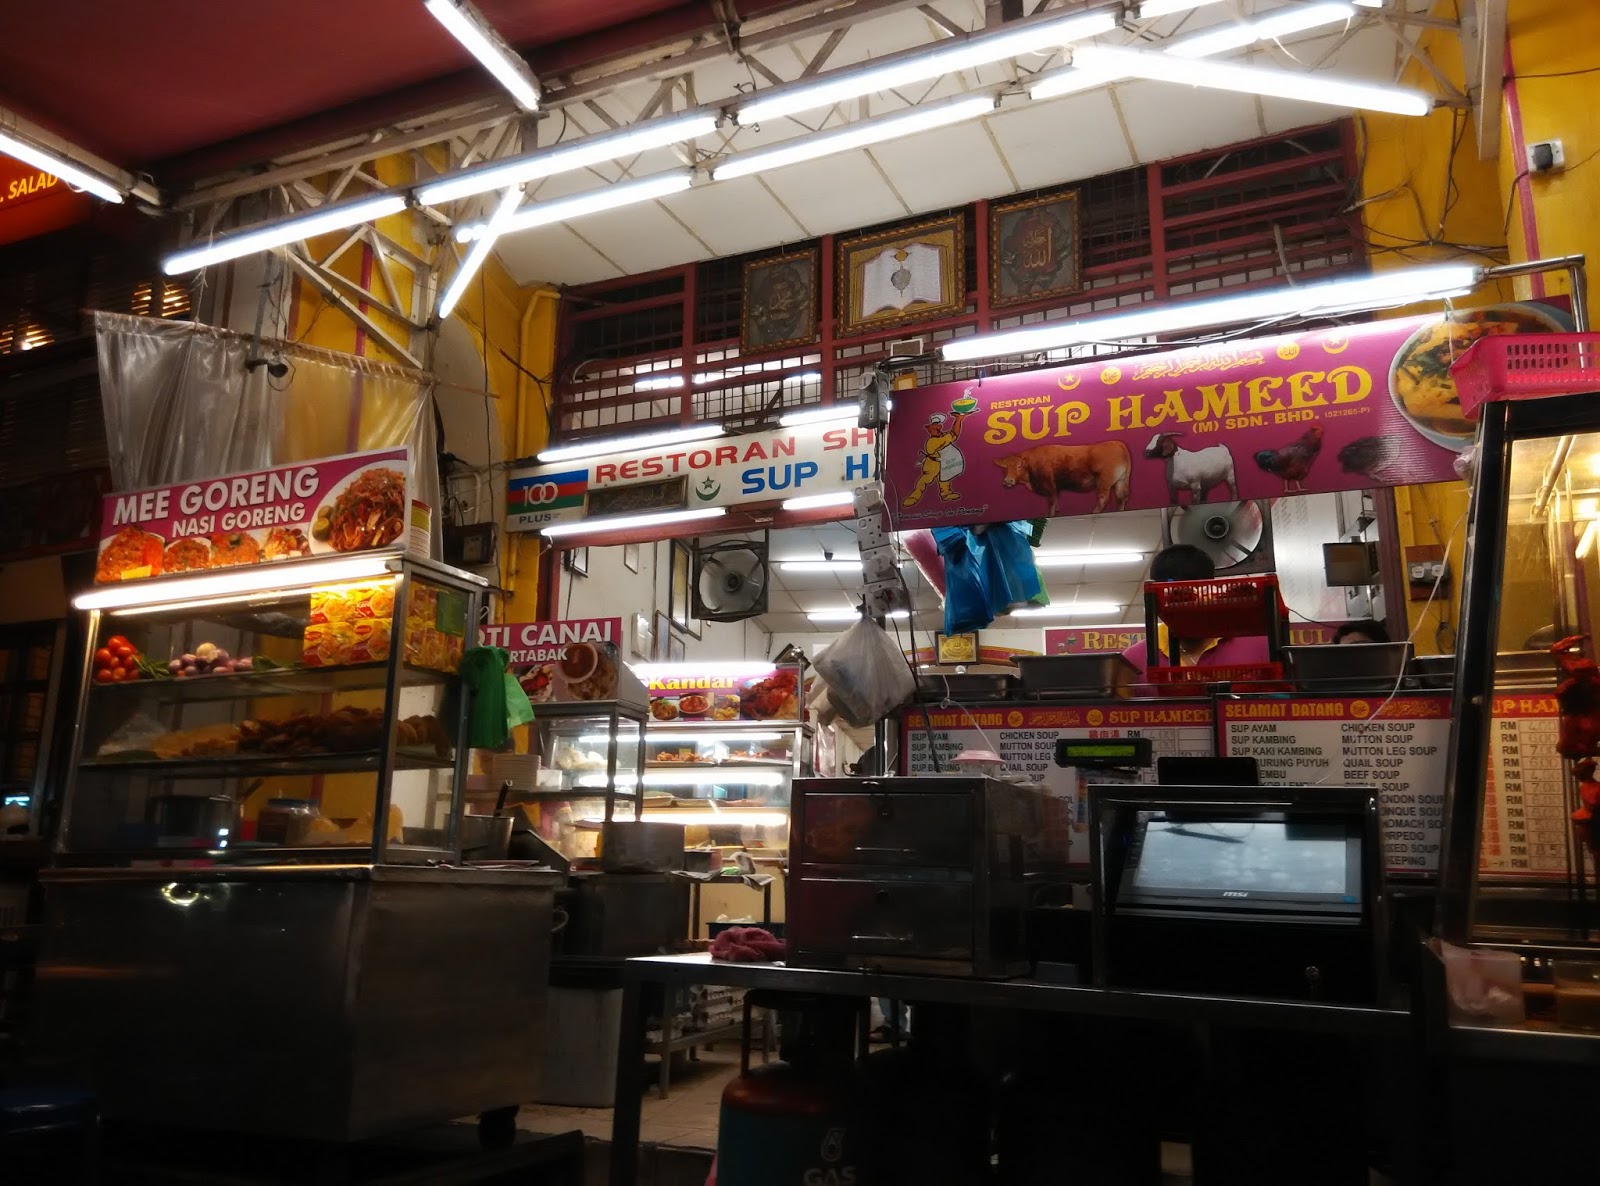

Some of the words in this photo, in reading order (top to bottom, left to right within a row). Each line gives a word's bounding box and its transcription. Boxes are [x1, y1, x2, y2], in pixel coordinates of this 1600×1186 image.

[8, 172, 58, 199] SALAD
[983, 400, 1091, 445] SUP
[1105, 365, 1373, 432] HAMEED
[990, 395, 1051, 410] RESTORAN
[1192, 420, 1220, 434] (M)
[1225, 414, 1268, 430] SDN.
[1274, 408, 1320, 424] BHD.
[595, 437, 796, 484] RESTORAN
[823, 427, 874, 452] SH
[741, 462, 819, 495] SUP
[845, 453, 876, 481] H
[112, 490, 171, 526] MEE
[180, 466, 320, 515] GORENG
[522, 482, 559, 506] 100
[172, 515, 216, 538] NASI
[221, 502, 307, 533] GORENG
[519, 513, 551, 524] PLUS
[520, 621, 612, 646] CANAI
[509, 648, 568, 663] RTABAK
[648, 674, 738, 690] Kandar
[1226, 703, 1286, 718] SELAMAT
[1292, 702, 1344, 717] DATANG
[908, 714, 957, 727] SEAMAT
[961, 713, 1003, 727] DATANG
[1109, 710, 1140, 724] SUP
[1231, 724, 1249, 733] SUP
[1251, 724, 1277, 733] AYAM
[1341, 723, 1385, 732] CHICKEN
[1387, 723, 1415, 732] SOUP
[1501, 722, 1516, 730] RM
[912, 733, 926, 741] SUP
[1000, 731, 1035, 740] CHICKEN
[1036, 731, 1059, 739] SOUP
[1127, 730, 1141, 738] RM
[1501, 734, 1517, 742] RM
[1231, 735, 1250, 744] SUP
[1252, 735, 1296, 744] KAMBING
[1342, 735, 1383, 744] MUTTON
[1385, 734, 1413, 744] SOUP
[912, 743, 926, 751] SUP
[1000, 742, 1034, 751] MUTTON
[1502, 746, 1518, 754] RM
[1232, 747, 1250, 756] SUP
[1252, 747, 1275, 756] KAKI
[1277, 747, 1322, 756] KAMBING
[1342, 747, 1384, 756] MUTTON
[1386, 747, 1406, 755] LEG
[1409, 747, 1437, 755] SOUP
[912, 754, 926, 762] SUP
[1000, 753, 1034, 761] MUTTON
[1035, 752, 1051, 760] LEG
[1296, 759, 1329, 767] PUYUH
[1343, 759, 1373, 768] QUAIL
[1376, 758, 1403, 767] SOUP
[1503, 758, 1519, 767] RM
[912, 764, 926, 772] SUP
[1000, 763, 1024, 772] QUAIL
[1025, 763, 1048, 771] SOUP
[1260, 770, 1286, 779] EMBU
[1344, 771, 1370, 779] BEEF
[1372, 771, 1400, 779] SOUP
[1504, 771, 1521, 779] RM
[1382, 782, 1410, 791] SOUP
[1505, 783, 1521, 792] RM
[1506, 796, 1522, 804] RM
[1419, 807, 1441, 816] SOU
[1507, 808, 1524, 817] RM
[1508, 821, 1524, 829] RM
[1509, 833, 1525, 842] RM
[1411, 844, 1439, 853] SOUP
[1511, 846, 1526, 855] RM
[1511, 859, 1528, 868] RM
[803, 1166, 857, 1186] GAS
